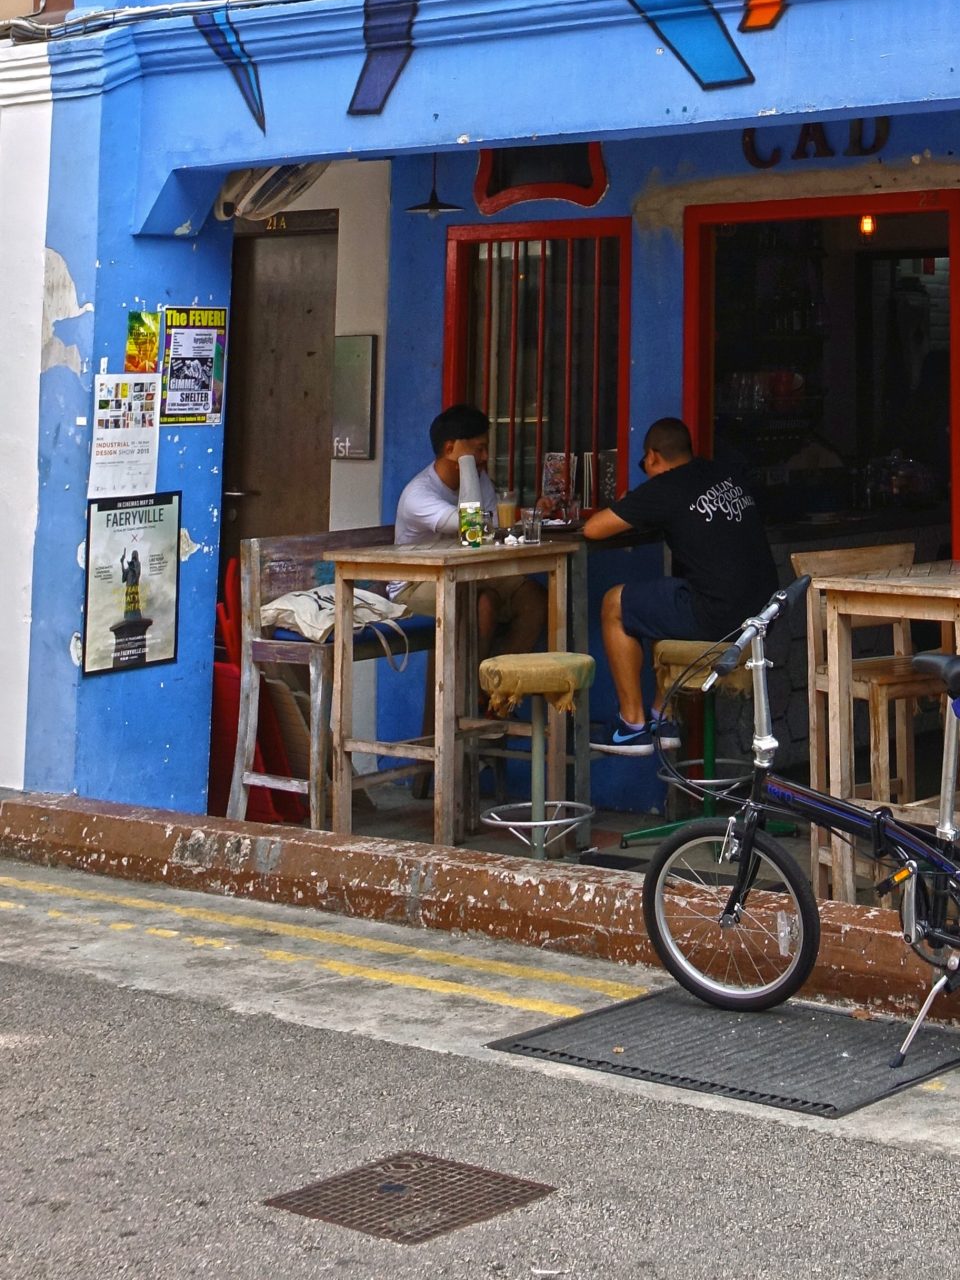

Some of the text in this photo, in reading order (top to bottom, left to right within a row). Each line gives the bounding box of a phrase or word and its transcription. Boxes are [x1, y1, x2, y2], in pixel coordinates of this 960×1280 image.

[743, 116, 890, 169] CAD
[166, 310, 225, 327] The FEVER!
[169, 378, 196, 390] GIMME
[179, 392, 209, 403] SHELTER
[118, 448, 136, 456] SHOW
[333, 437, 351, 457] fst
[106, 508, 164, 528] FAERYVILLE
